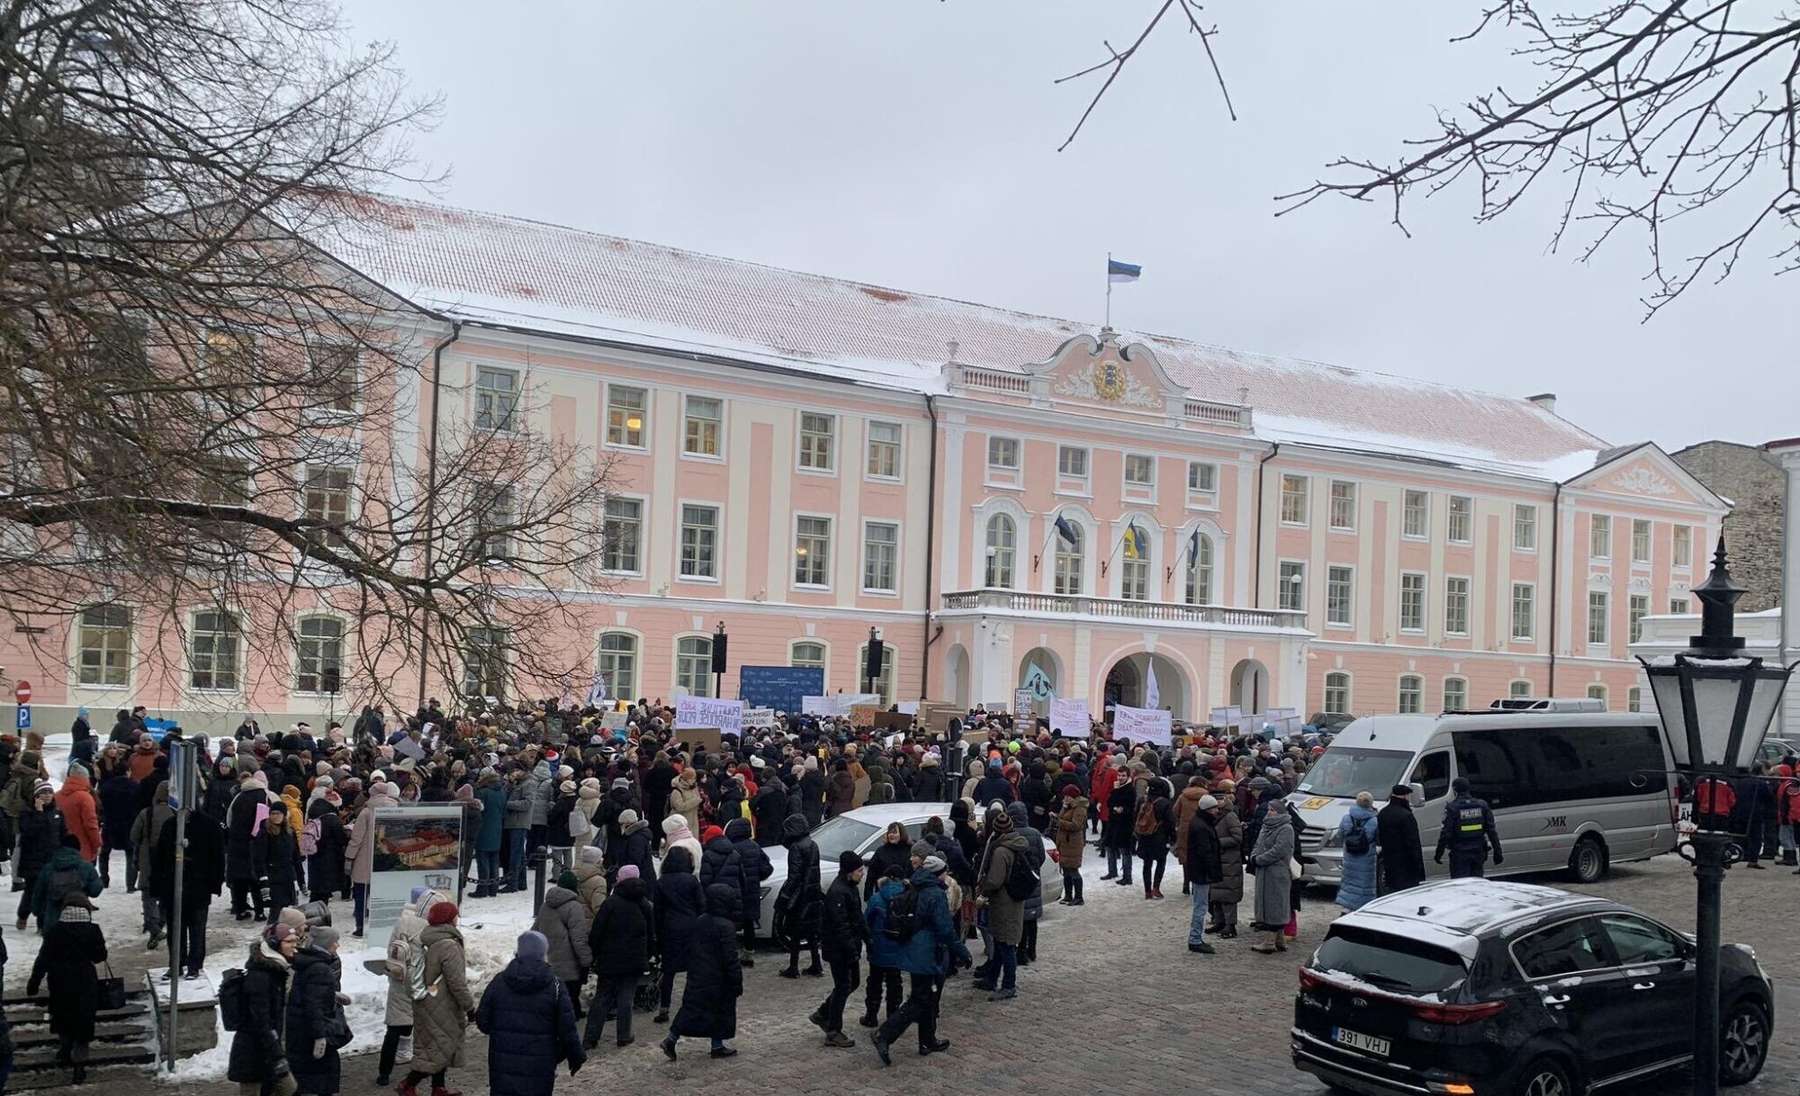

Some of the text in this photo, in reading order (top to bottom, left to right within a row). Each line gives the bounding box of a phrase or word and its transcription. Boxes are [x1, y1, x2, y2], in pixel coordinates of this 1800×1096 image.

[19, 709, 28, 726] P
[1551, 815, 1567, 827] MK
[1339, 1029, 1388, 1053] 391 VHJ
